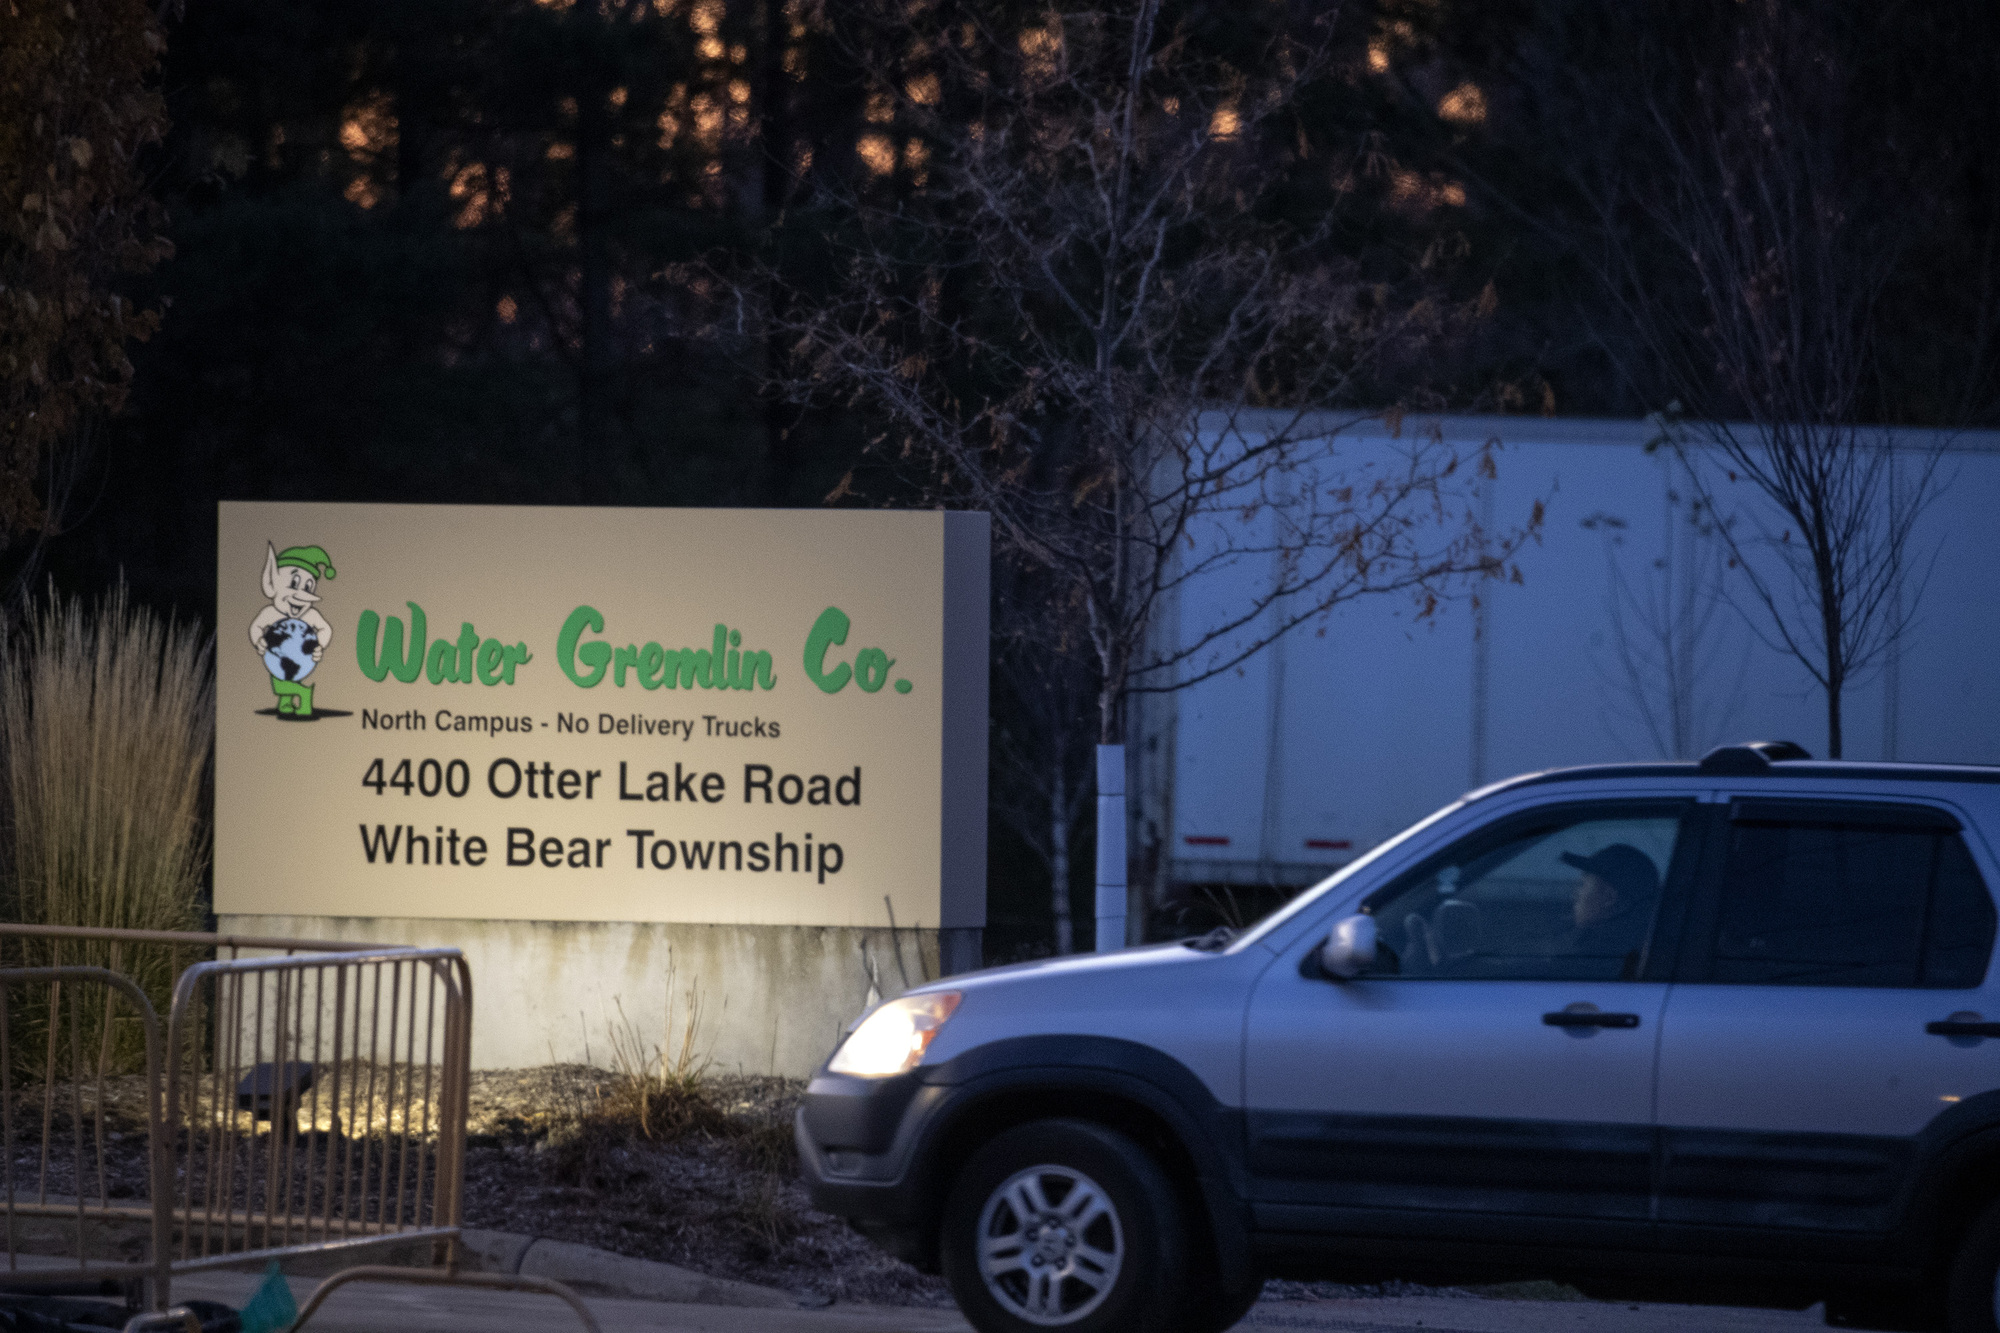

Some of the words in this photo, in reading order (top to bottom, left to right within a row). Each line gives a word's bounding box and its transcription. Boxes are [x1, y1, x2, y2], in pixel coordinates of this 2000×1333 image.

[355, 601, 532, 687] Water
[556, 604, 776, 691] Gremlin
[802, 606, 913, 695] Co.
[361, 708, 427, 731] North
[434, 709, 533, 738] Campus
[557, 712, 590, 734] No
[598, 713, 695, 742] Delivery
[702, 715, 781, 739] Trucks
[361, 757, 471, 799] 4400
[487, 757, 602, 801] Otter
[618, 760, 726, 804] Lake
[743, 763, 862, 807] Road
[358, 823, 488, 867] White
[506, 826, 612, 869] Bear
[626, 828, 845, 885] Township
